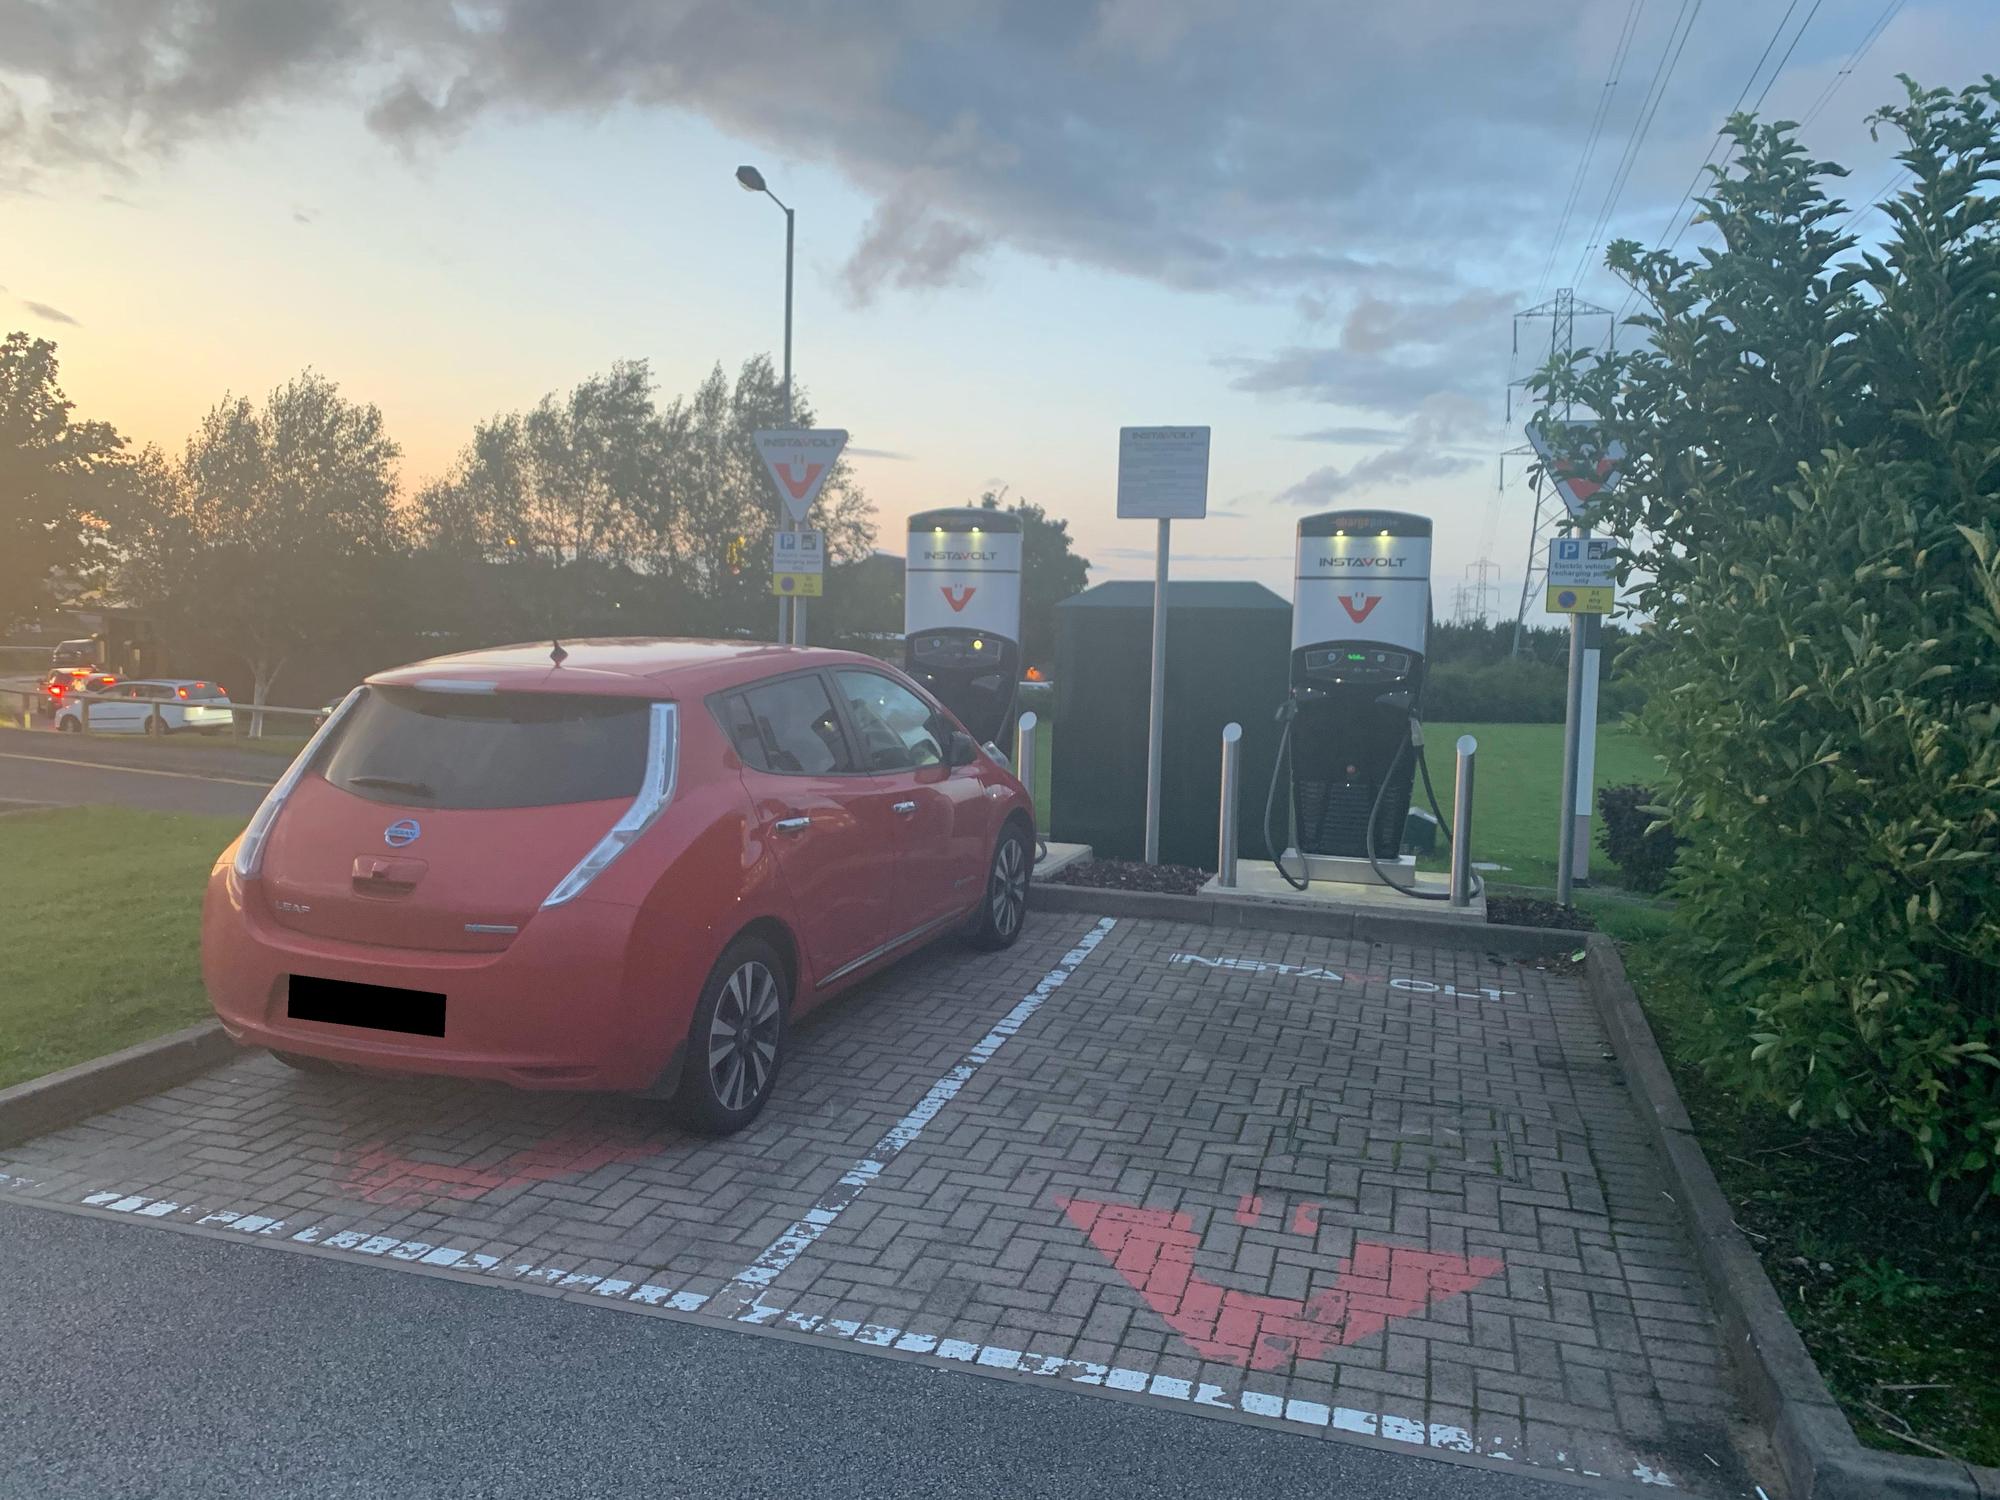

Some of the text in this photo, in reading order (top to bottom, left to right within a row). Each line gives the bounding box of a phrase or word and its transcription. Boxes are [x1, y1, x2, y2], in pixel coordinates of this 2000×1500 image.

[924, 551, 998, 561] INSTAVOLT
[1564, 543, 1577, 558] P
[1319, 557, 1408, 567] INSTAVOLT
[1169, 952, 1518, 1001] INSTAVOLT
